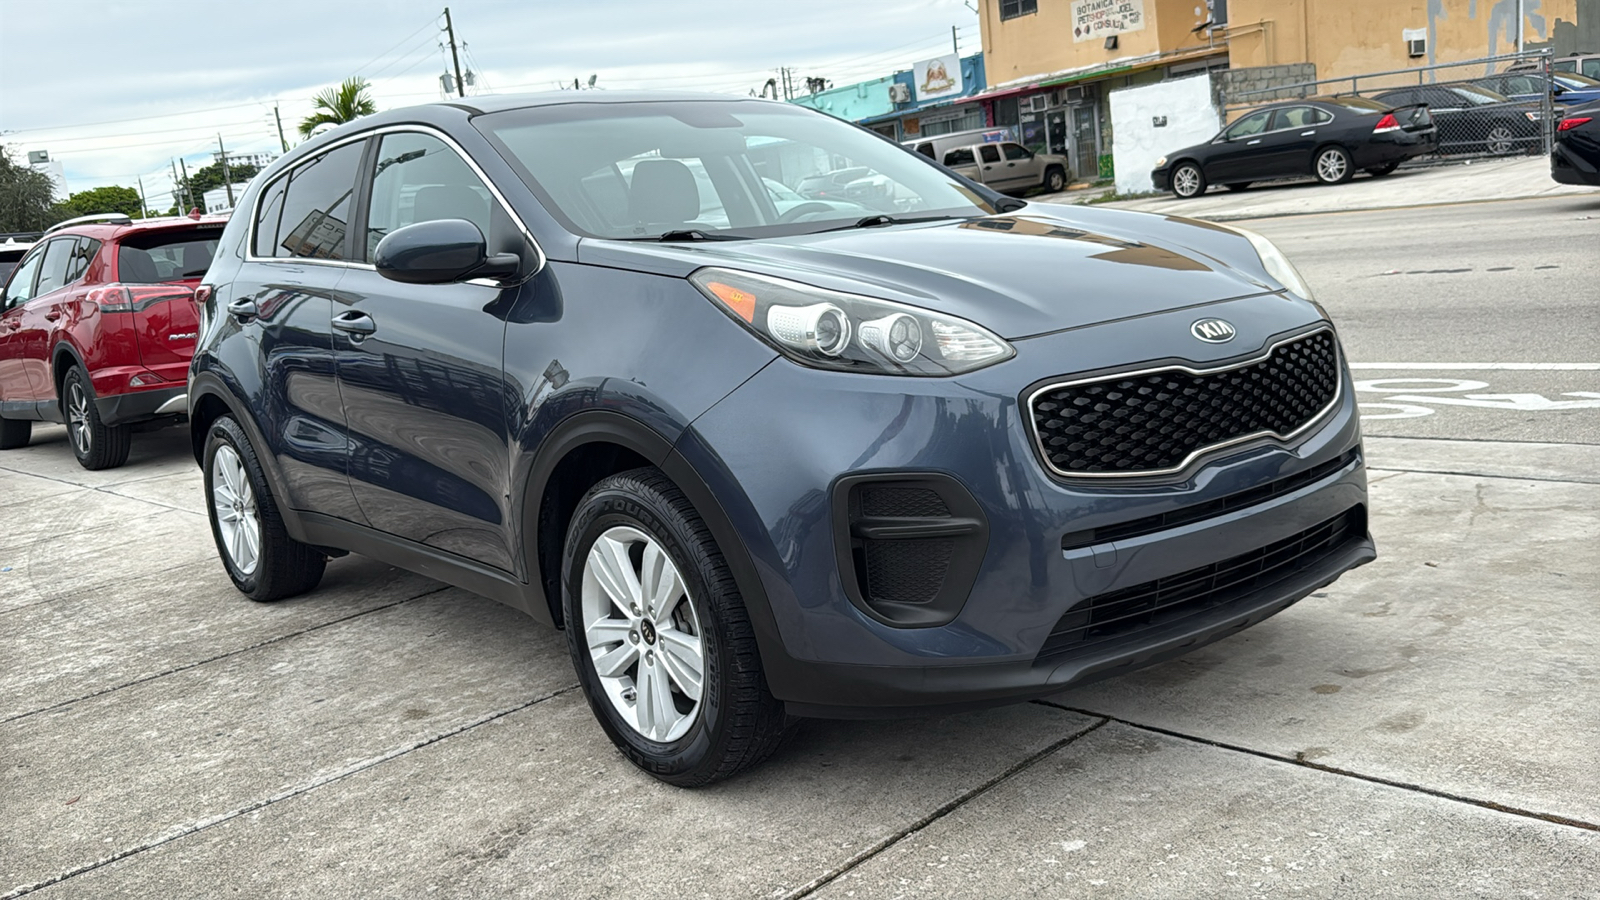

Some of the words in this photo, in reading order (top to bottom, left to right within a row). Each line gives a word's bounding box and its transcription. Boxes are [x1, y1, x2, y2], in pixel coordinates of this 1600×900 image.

[1077, 0, 1113, 15] BOTANICA
[1196, 320, 1233, 339] KIA
[567, 505, 598, 558] EDGE
[602, 499, 686, 566] TOURING
[642, 620, 654, 643] KIA
[619, 745, 685, 774] KELLY
